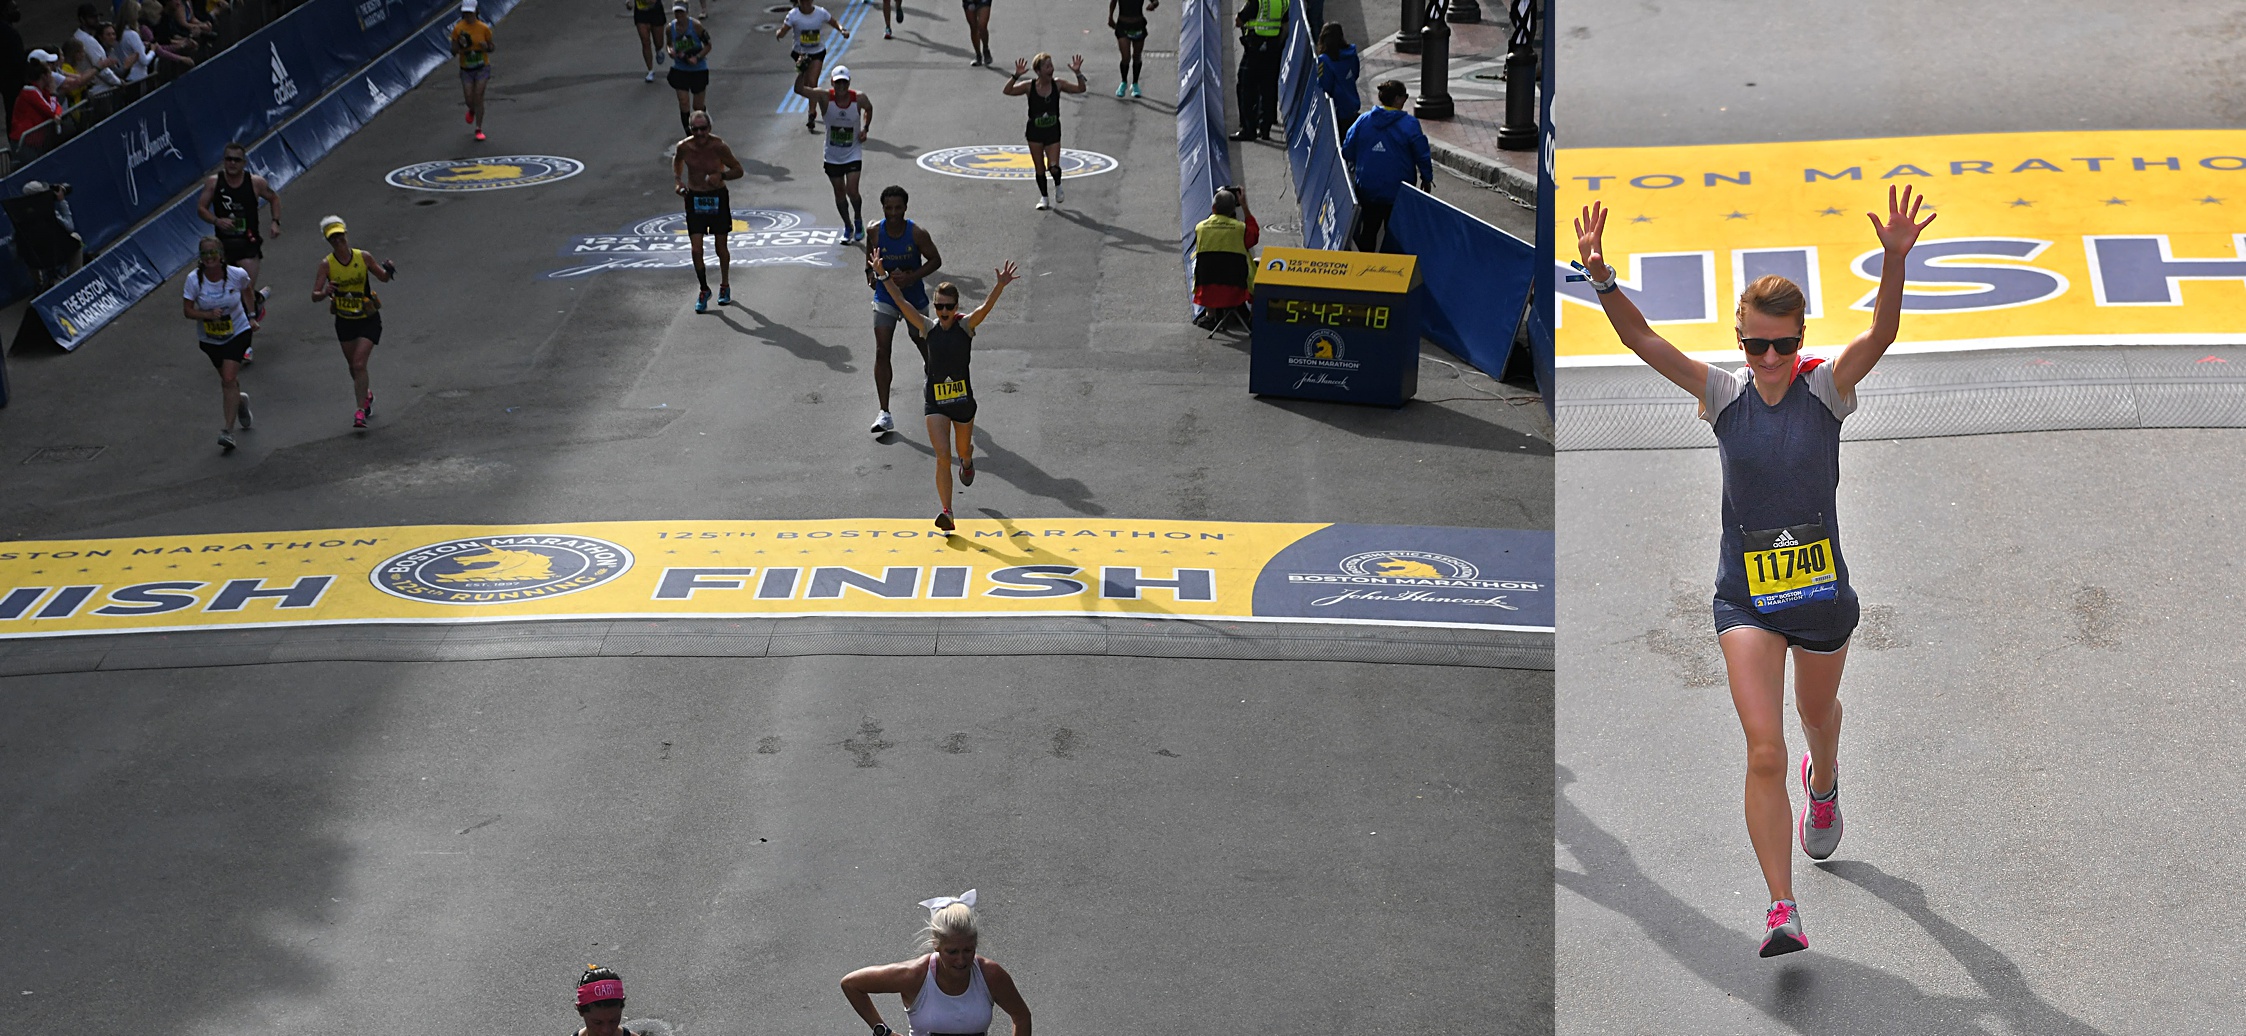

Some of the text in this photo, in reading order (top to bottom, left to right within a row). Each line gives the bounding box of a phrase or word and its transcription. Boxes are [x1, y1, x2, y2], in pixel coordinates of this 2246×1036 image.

[274, 79, 298, 105] adidas
[1555, 171, 1752, 191] TON
[1287, 266, 1347, 276] MARATHON
[1310, 261, 1348, 269] BOSTON
[1378, 265, 1404, 277] Hancock
[63, 277, 108, 313] THE BOSTON
[73, 291, 119, 329] MARATHON
[1285, 301, 1390, 329] 5:42:18
[1288, 357, 1360, 369] BOSTON MARATHON
[937, 381, 964, 396] 11740
[1292, 371, 1350, 391] John Hancock
[657, 531, 756, 540] 125TH
[776, 530, 950, 539] BOSTON
[1772, 540, 1799, 548] adidas
[388, 537, 613, 573] BOSTON MARATHON
[1754, 544, 1827, 582] 11740
[650, 565, 1217, 602] FINISH
[1288, 574, 1388, 584] BOSTON
[449, 575, 597, 601] RUNNING
[1778, 590, 1802, 599] BOSTON
[1311, 588, 1519, 611] John Hancock
[1767, 595, 1804, 606] MARATHON
[594, 983, 615, 997] GABY
